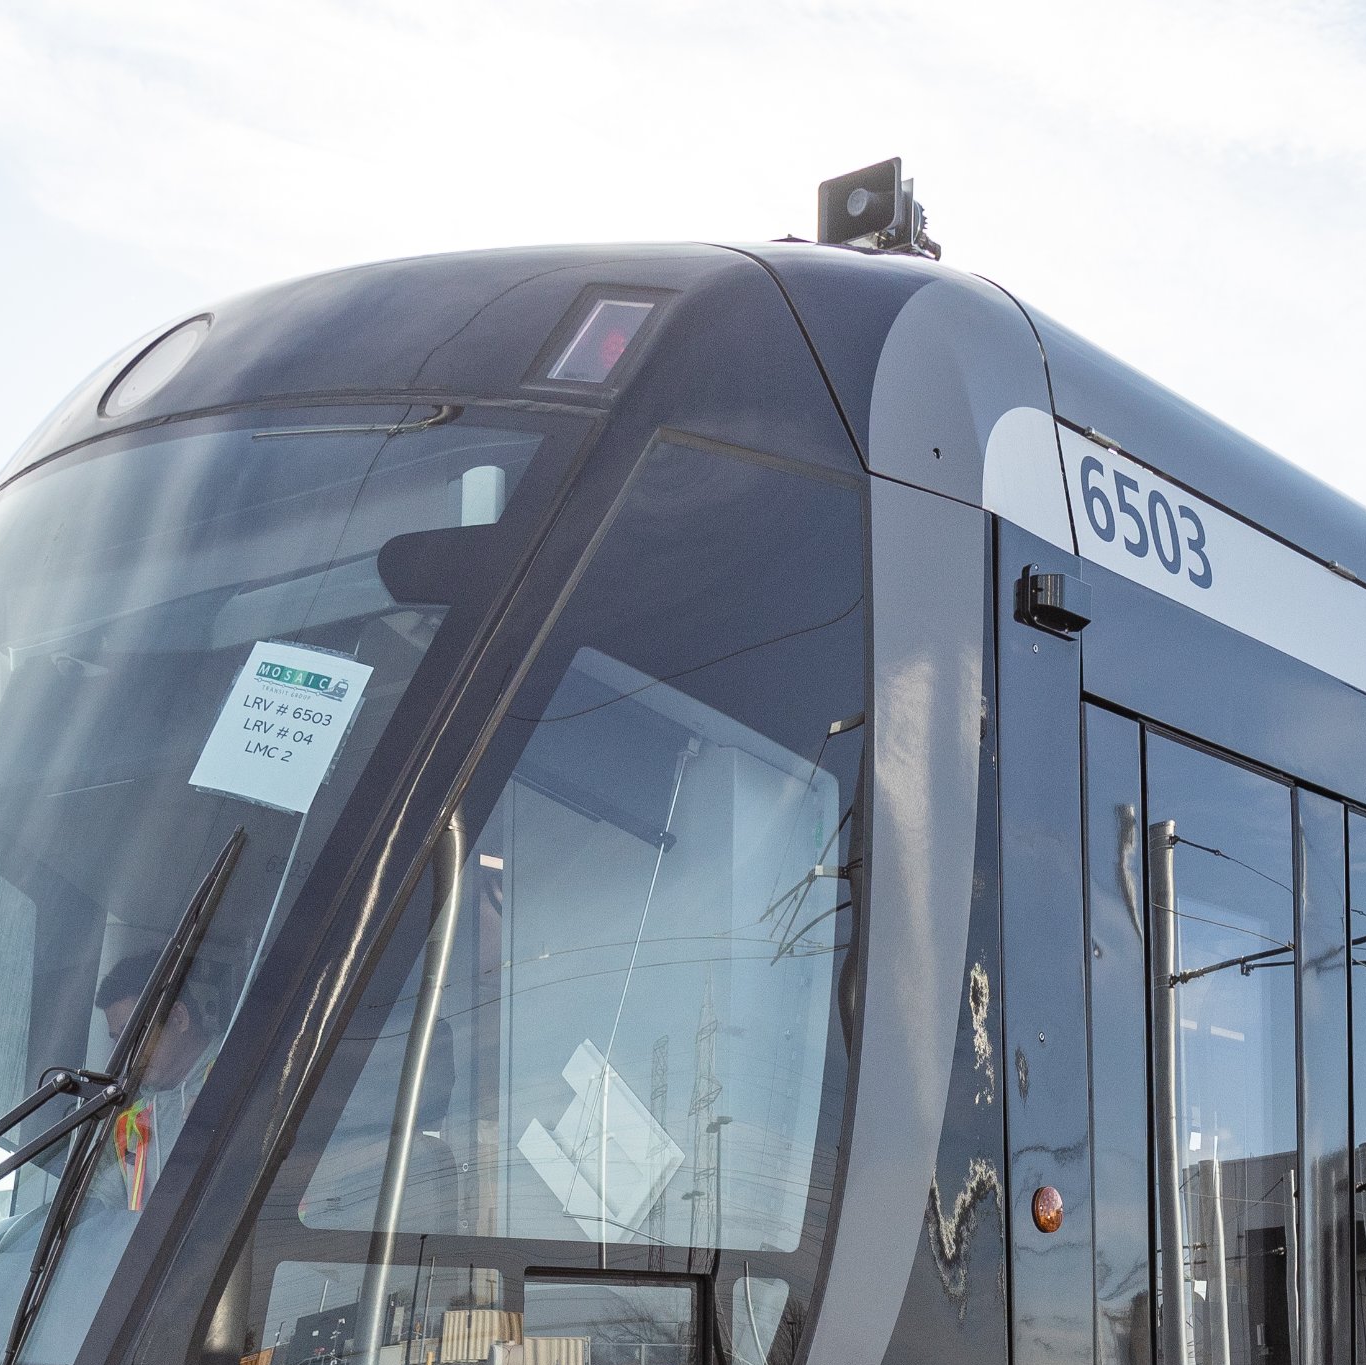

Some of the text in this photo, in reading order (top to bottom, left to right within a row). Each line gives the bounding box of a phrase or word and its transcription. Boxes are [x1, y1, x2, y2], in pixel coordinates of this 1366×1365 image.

[1080, 455, 1213, 590] 6503
[257, 663, 329, 690] MOSAIC
[262, 684, 289, 696] TRANSIT
[243, 694, 333, 726] LRV # 6503
[243, 717, 313, 745] LRV # 04
[244, 740, 293, 762] LMC 2
